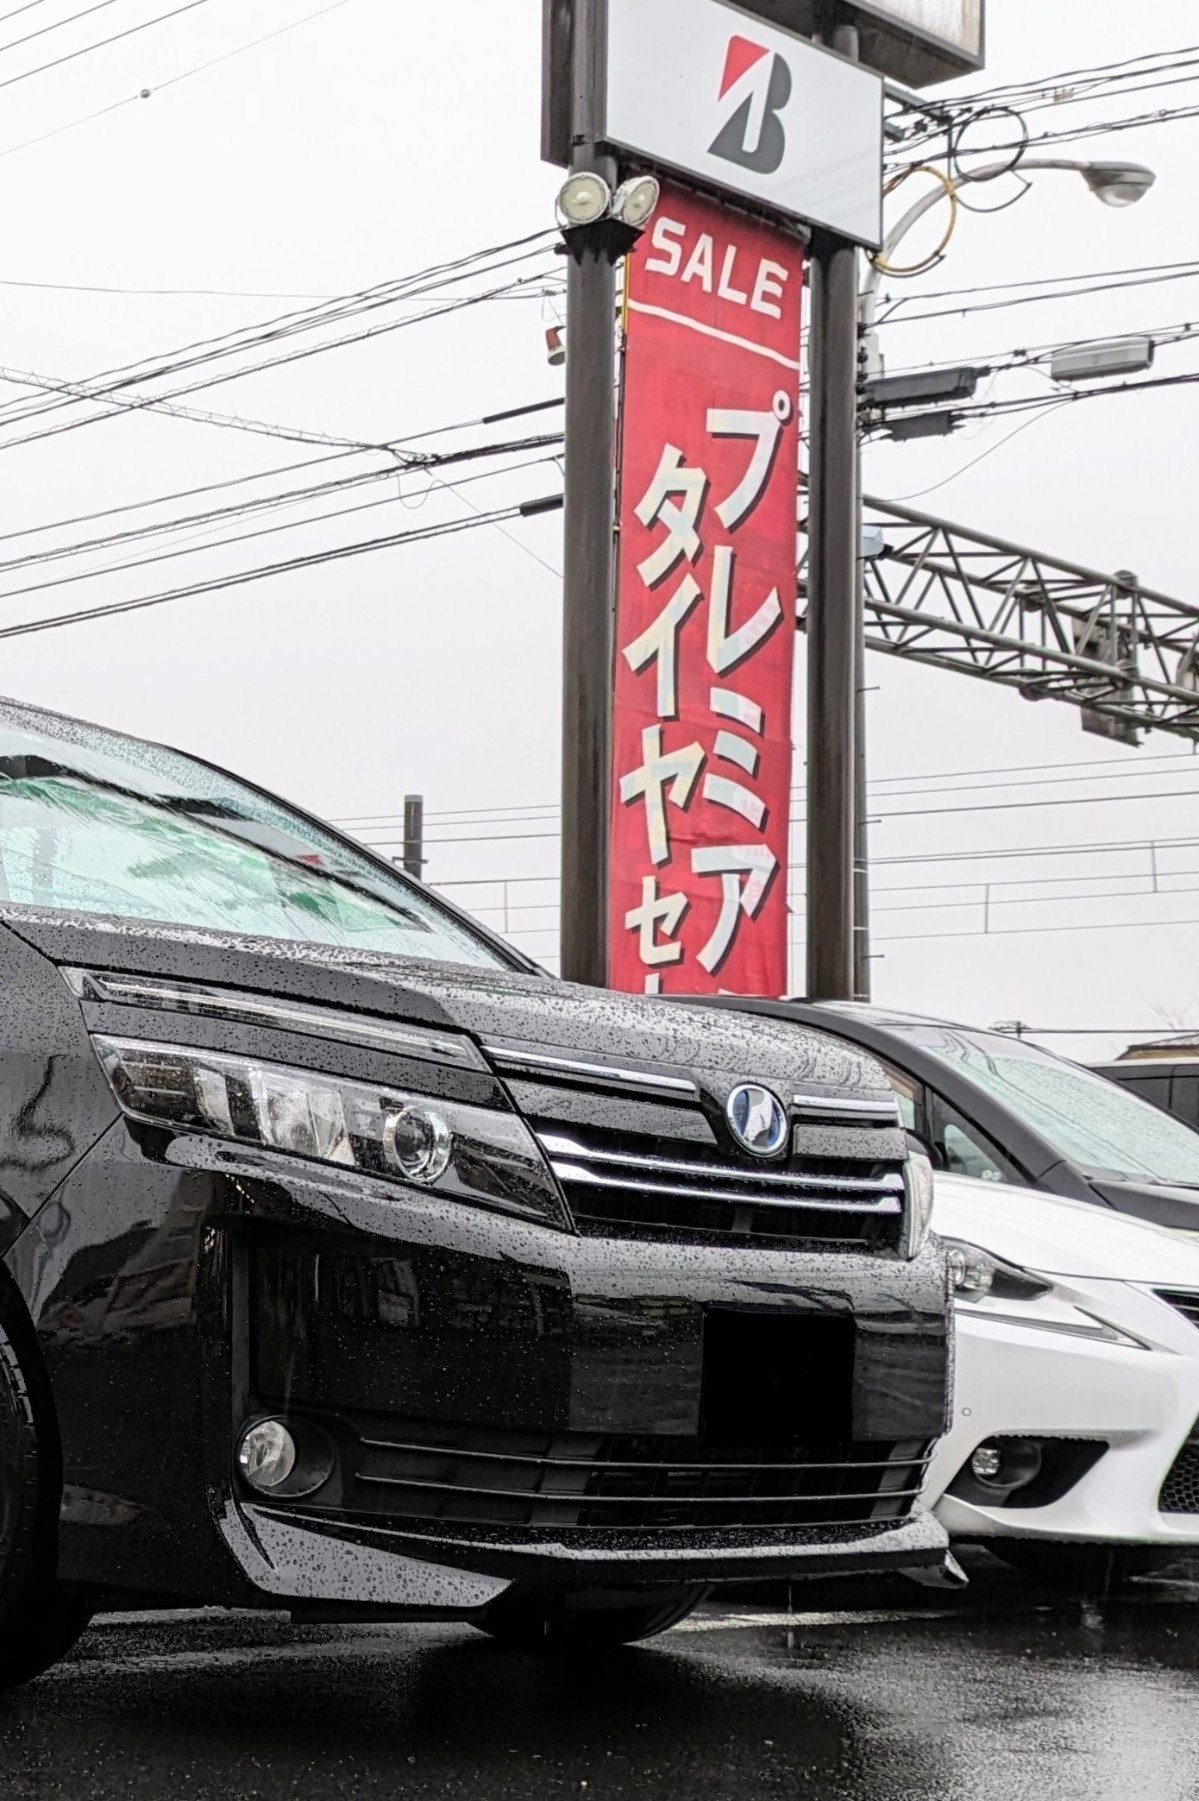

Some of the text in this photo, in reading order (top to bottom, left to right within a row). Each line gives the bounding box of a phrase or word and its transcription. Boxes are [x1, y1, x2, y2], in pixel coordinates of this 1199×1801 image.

[644, 216, 789, 320] SALE
[690, 389, 791, 995] プレミア
